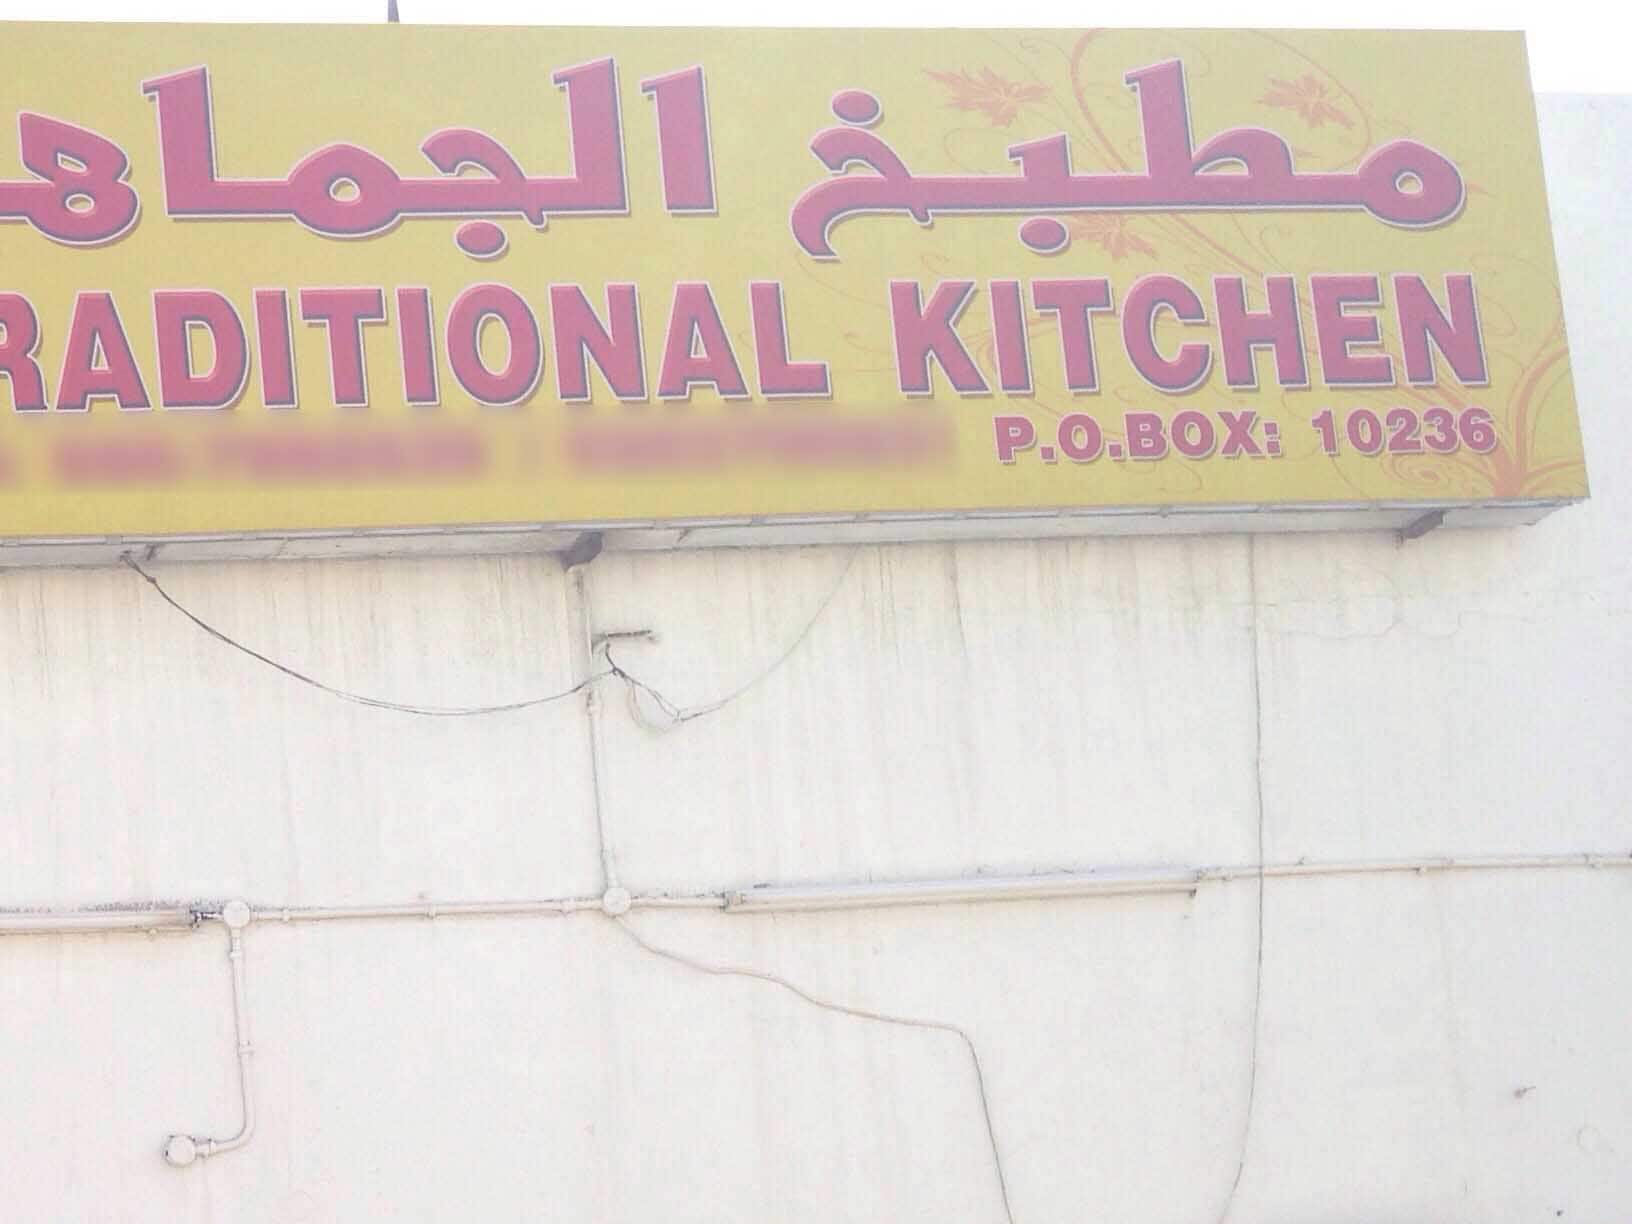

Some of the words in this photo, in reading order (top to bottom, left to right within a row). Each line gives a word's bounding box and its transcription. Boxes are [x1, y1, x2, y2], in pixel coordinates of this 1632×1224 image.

[791, 57, 1466, 261] مطبخ
[888, 272, 1489, 398] KITCHEN
[993, 409, 1283, 465] P.O.BOX:
[1311, 405, 1497, 457] 10236
